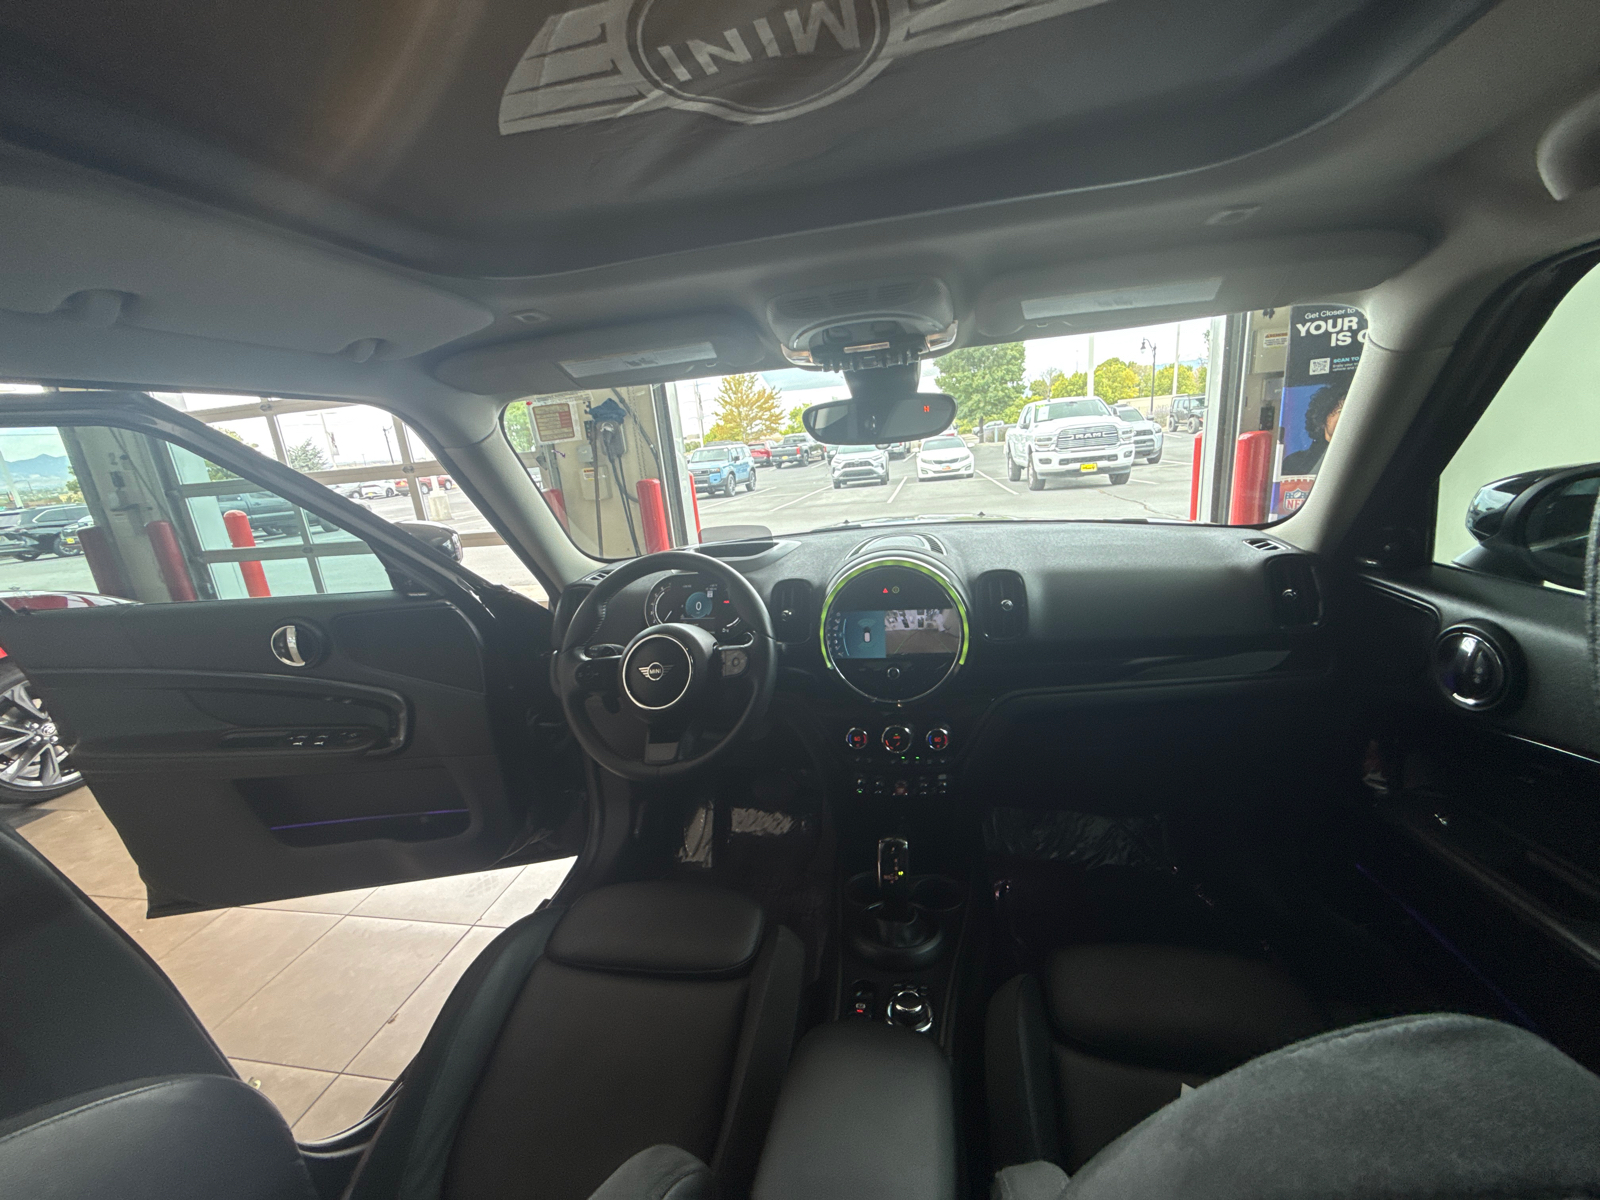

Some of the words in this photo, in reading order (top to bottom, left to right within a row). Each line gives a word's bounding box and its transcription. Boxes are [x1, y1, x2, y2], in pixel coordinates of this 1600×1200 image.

[657, 0, 862, 82] MINI
[1304, 311, 1319, 319] Get
[1320, 309, 1346, 317] Closer
[1296, 316, 1358, 337] YOUR
[1330, 331, 1352, 347] IS
[1286, 499, 1305, 510] NF
[695, 601, 702, 611] 0
